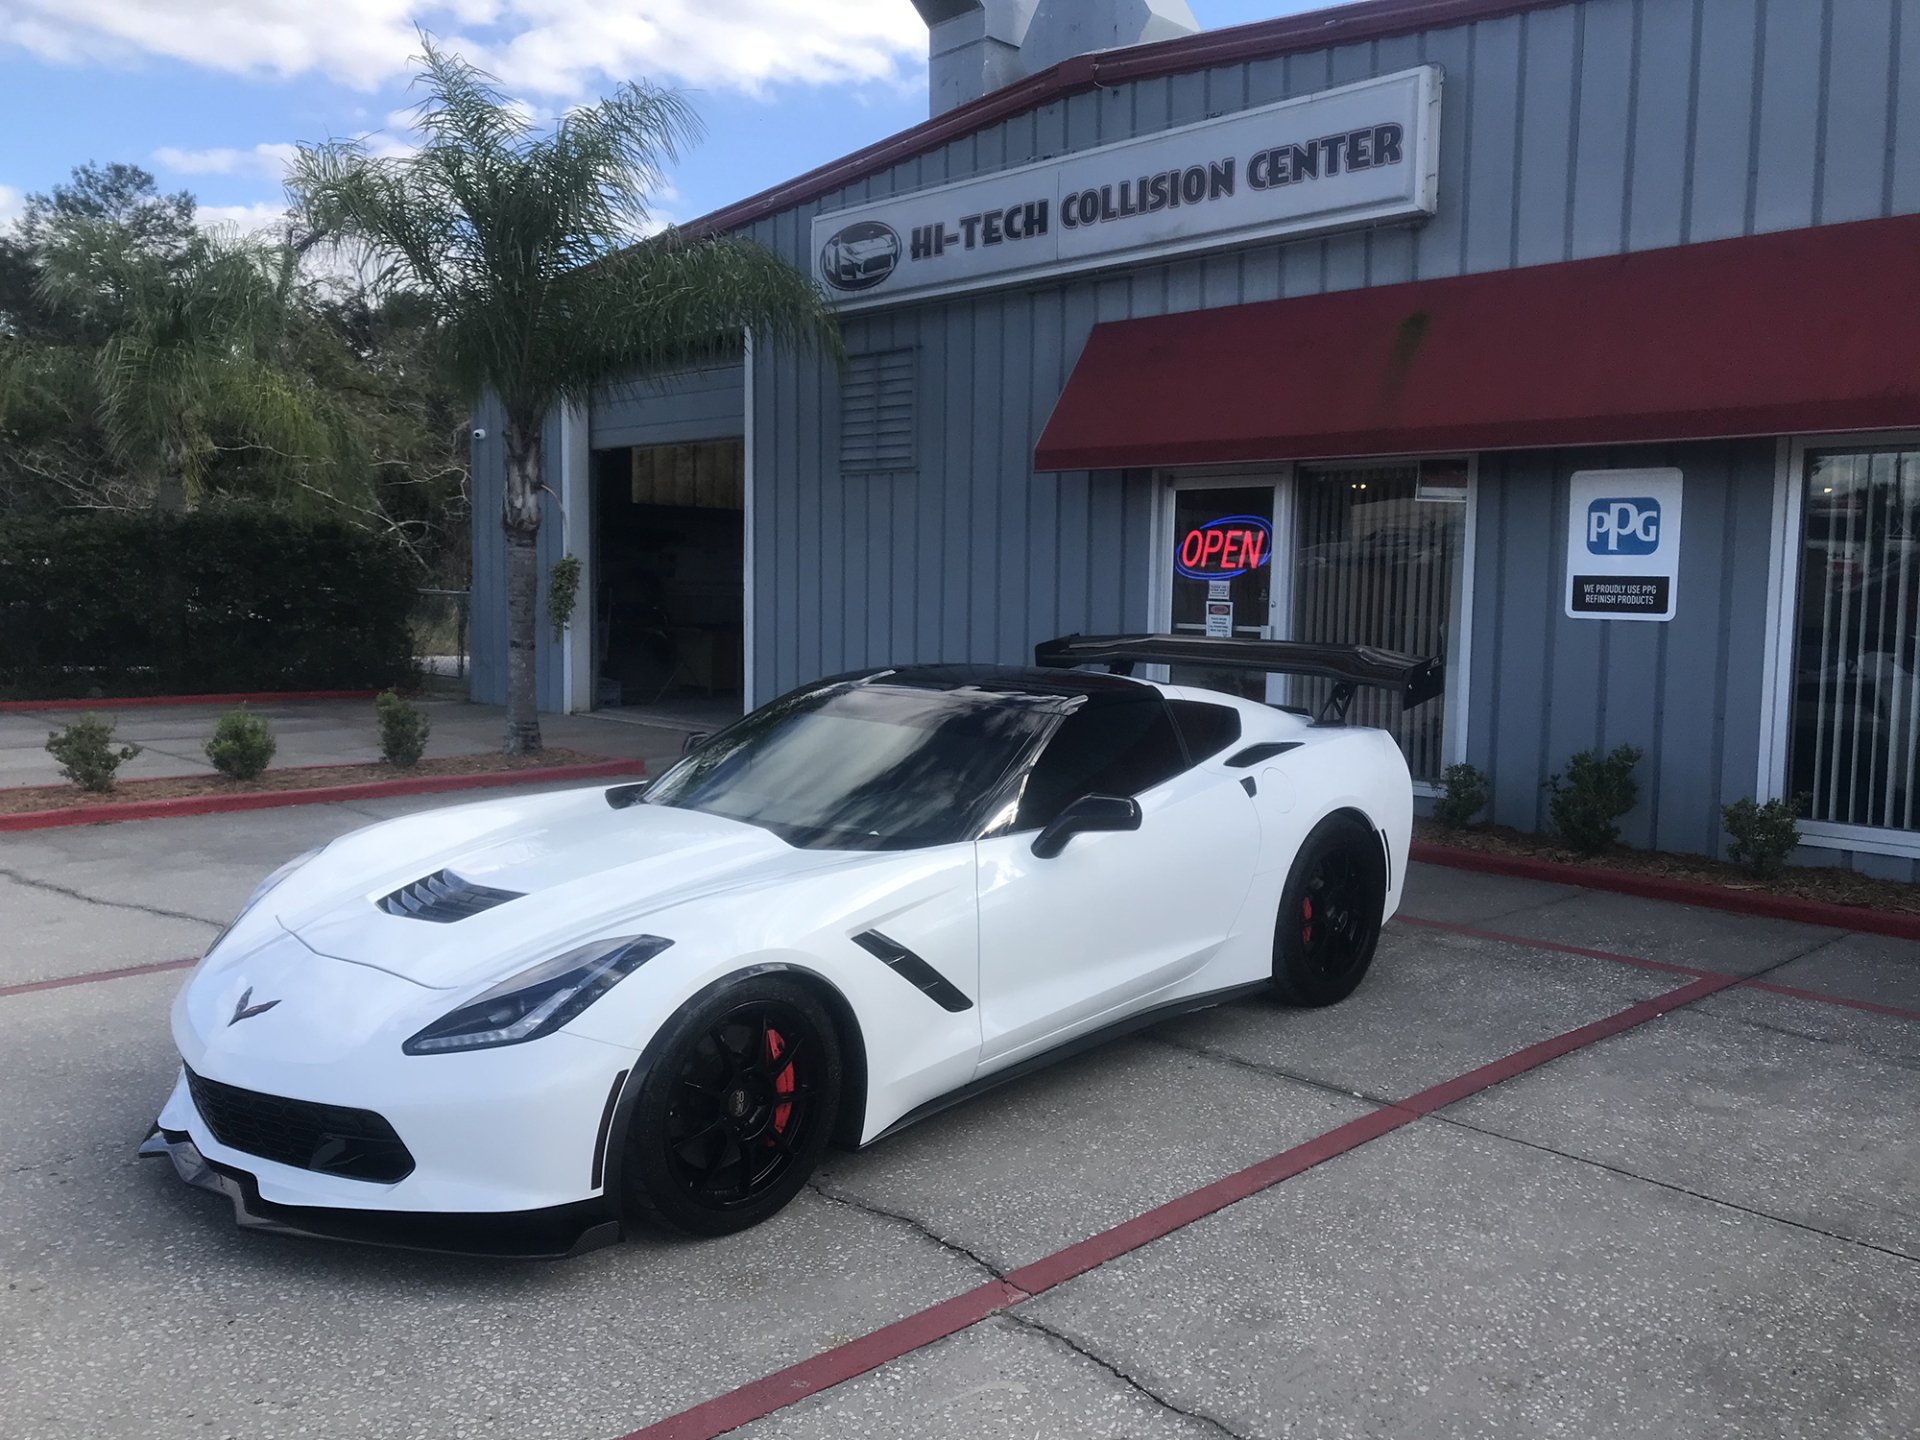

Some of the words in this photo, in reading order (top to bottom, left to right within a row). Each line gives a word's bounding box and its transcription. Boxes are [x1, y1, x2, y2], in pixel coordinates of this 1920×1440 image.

[910, 199, 1048, 261] HI-TECH
[1060, 156, 1236, 230] COLLISION
[1246, 122, 1404, 191] CENTER
[1589, 503, 1658, 550] PPG
[1181, 529, 1265, 569] OPEN
[1583, 584, 1595, 593] WE
[1595, 584, 1626, 594] PROUDLY
[1627, 585, 1641, 594] USE
[1642, 585, 1657, 594] PPG
[1585, 594, 1616, 604] REFINISH
[1617, 595, 1654, 605] PRODUCTS
